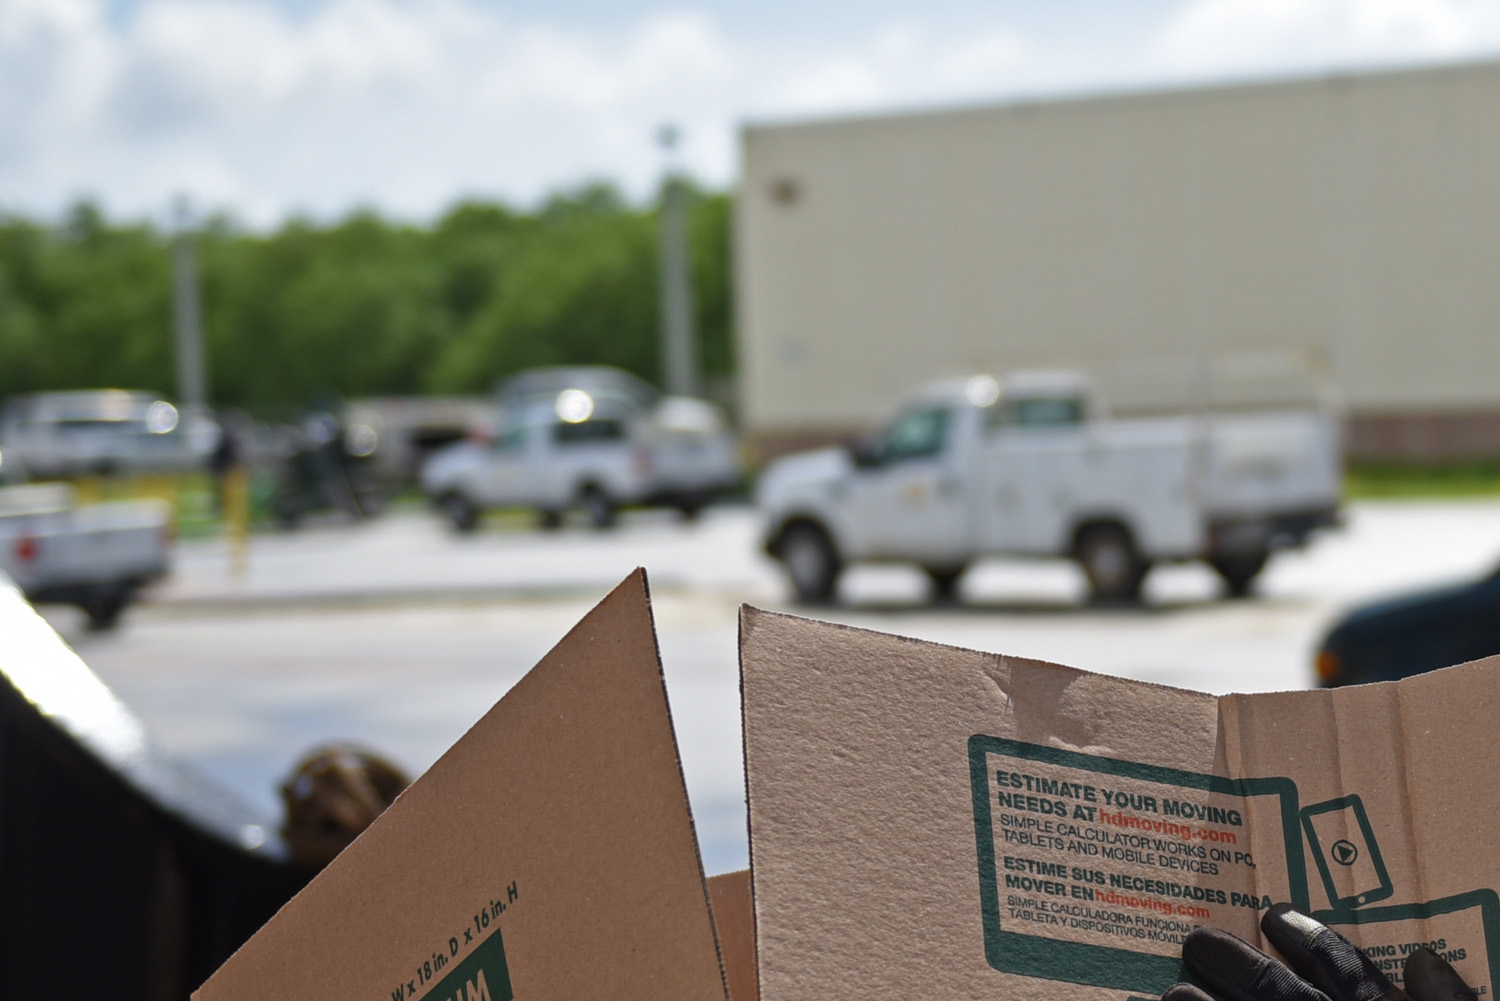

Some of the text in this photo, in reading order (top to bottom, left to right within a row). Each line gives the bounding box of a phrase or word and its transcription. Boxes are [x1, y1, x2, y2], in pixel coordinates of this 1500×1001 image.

[996, 769, 1243, 827] ESTIMATE YOUR MOVING
[997, 790, 1238, 845] NEEDS AT hdmoving.com
[1000, 813, 1257, 870] SIMPLE CALCULATOR WORKS ON PC,
[1002, 828, 1219, 876] TABLETS AND MOBILE DEVICES
[1003, 855, 1273, 912] ESTIME SUS NECESIDADES PARA
[1004, 873, 1211, 920] MOVER EN hdmoving.com
[406, 979, 416, 998] x
[416, 960, 432, 986] 18
[432, 952, 448, 973] in.
[448, 936, 459, 958] D
[463, 927, 473, 946] x
[473, 907, 490, 934] 16
[490, 900, 506, 920] in.
[506, 879, 519, 905] H
[1007, 895, 1191, 934] SIMPLE CALCULADORA FUNCIONA
[1010, 908, 1058, 926] TABLETA
[1059, 913, 1067, 925] Y
[1070, 916, 1145, 940] DISPOSITIVOS
[1362, 943, 1397, 959] KING
